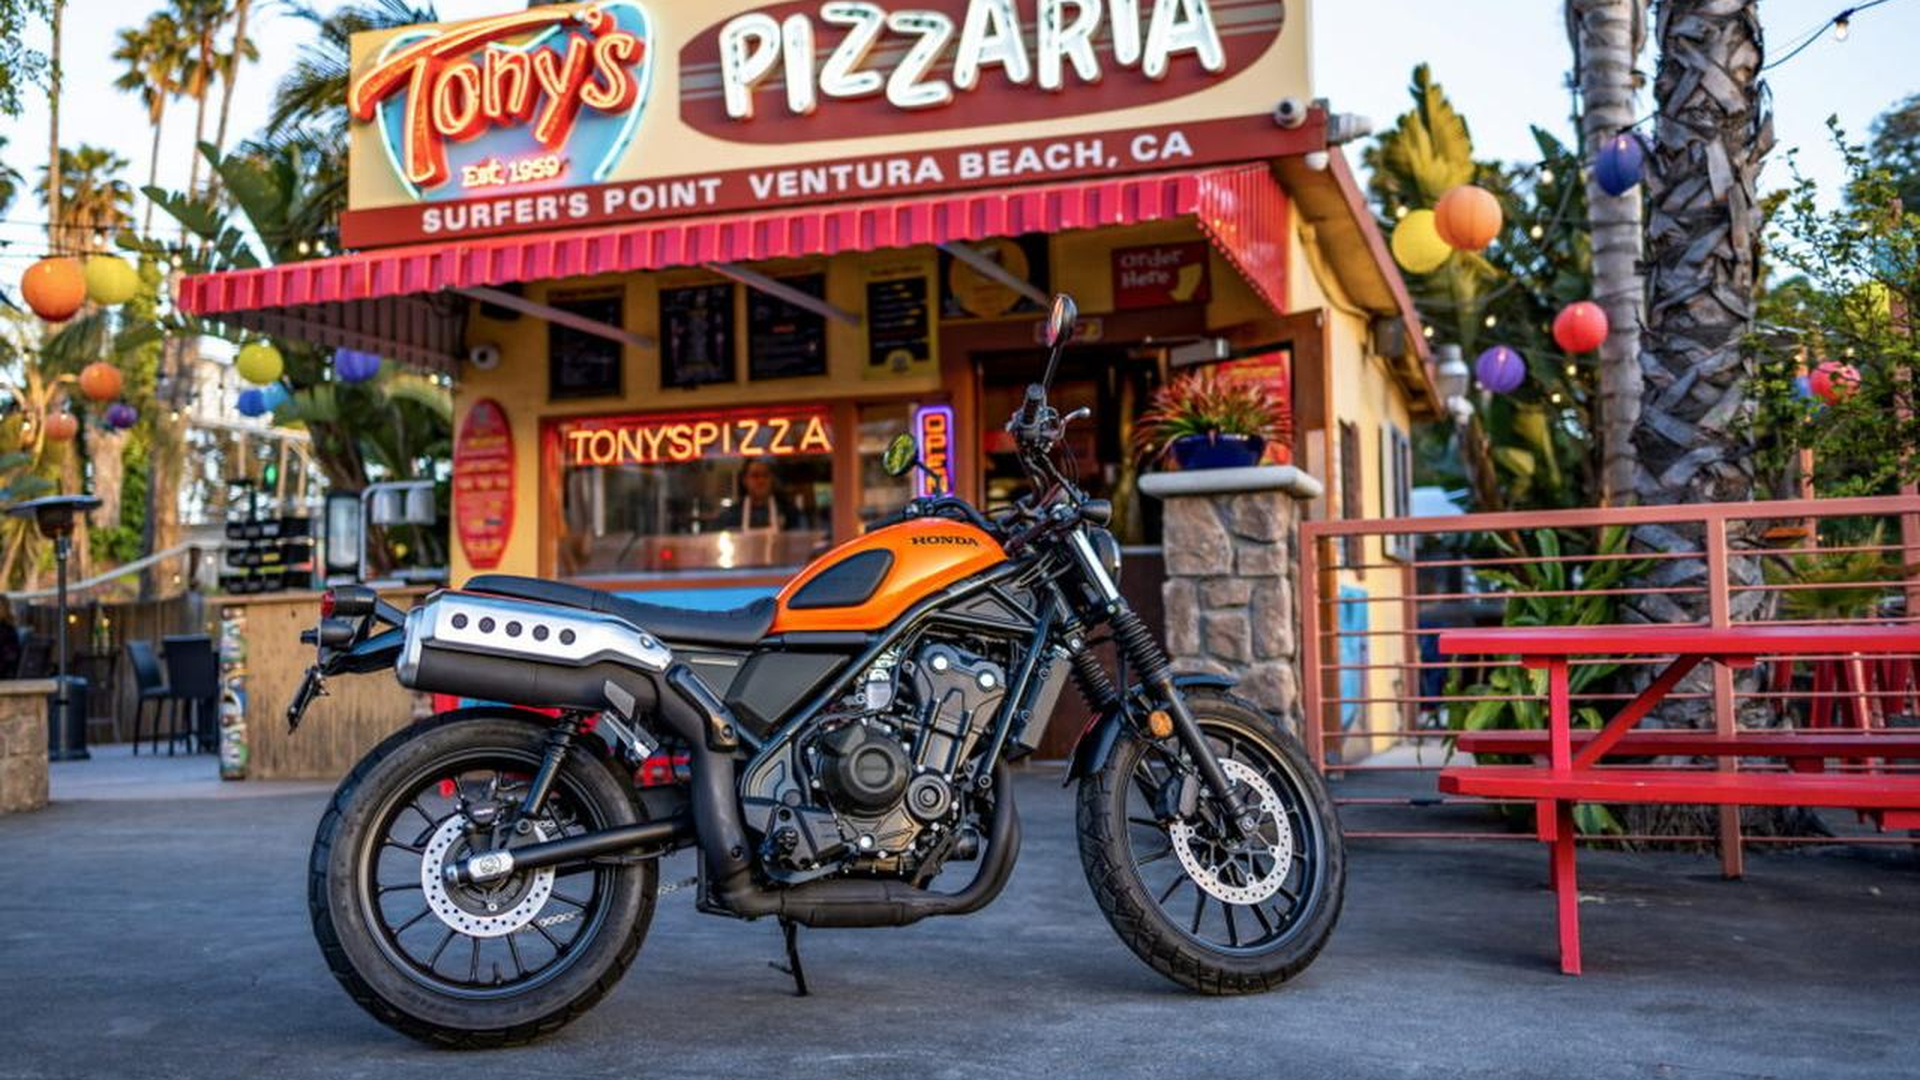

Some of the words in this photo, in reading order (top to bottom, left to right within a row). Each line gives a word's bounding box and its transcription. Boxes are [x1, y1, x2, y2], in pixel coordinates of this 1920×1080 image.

[350, 5, 645, 188] Tony's
[719, 0, 1226, 119] PIZZARIA
[422, 191, 590, 234] SURFER'S
[603, 178, 722, 214] POINT
[748, 157, 944, 200] VENTURA
[958, 138, 1119, 181] BEACH,
[1130, 130, 1194, 162] CA
[508, 154, 559, 183] 1959
[912, 536, 979, 547] HONDA
